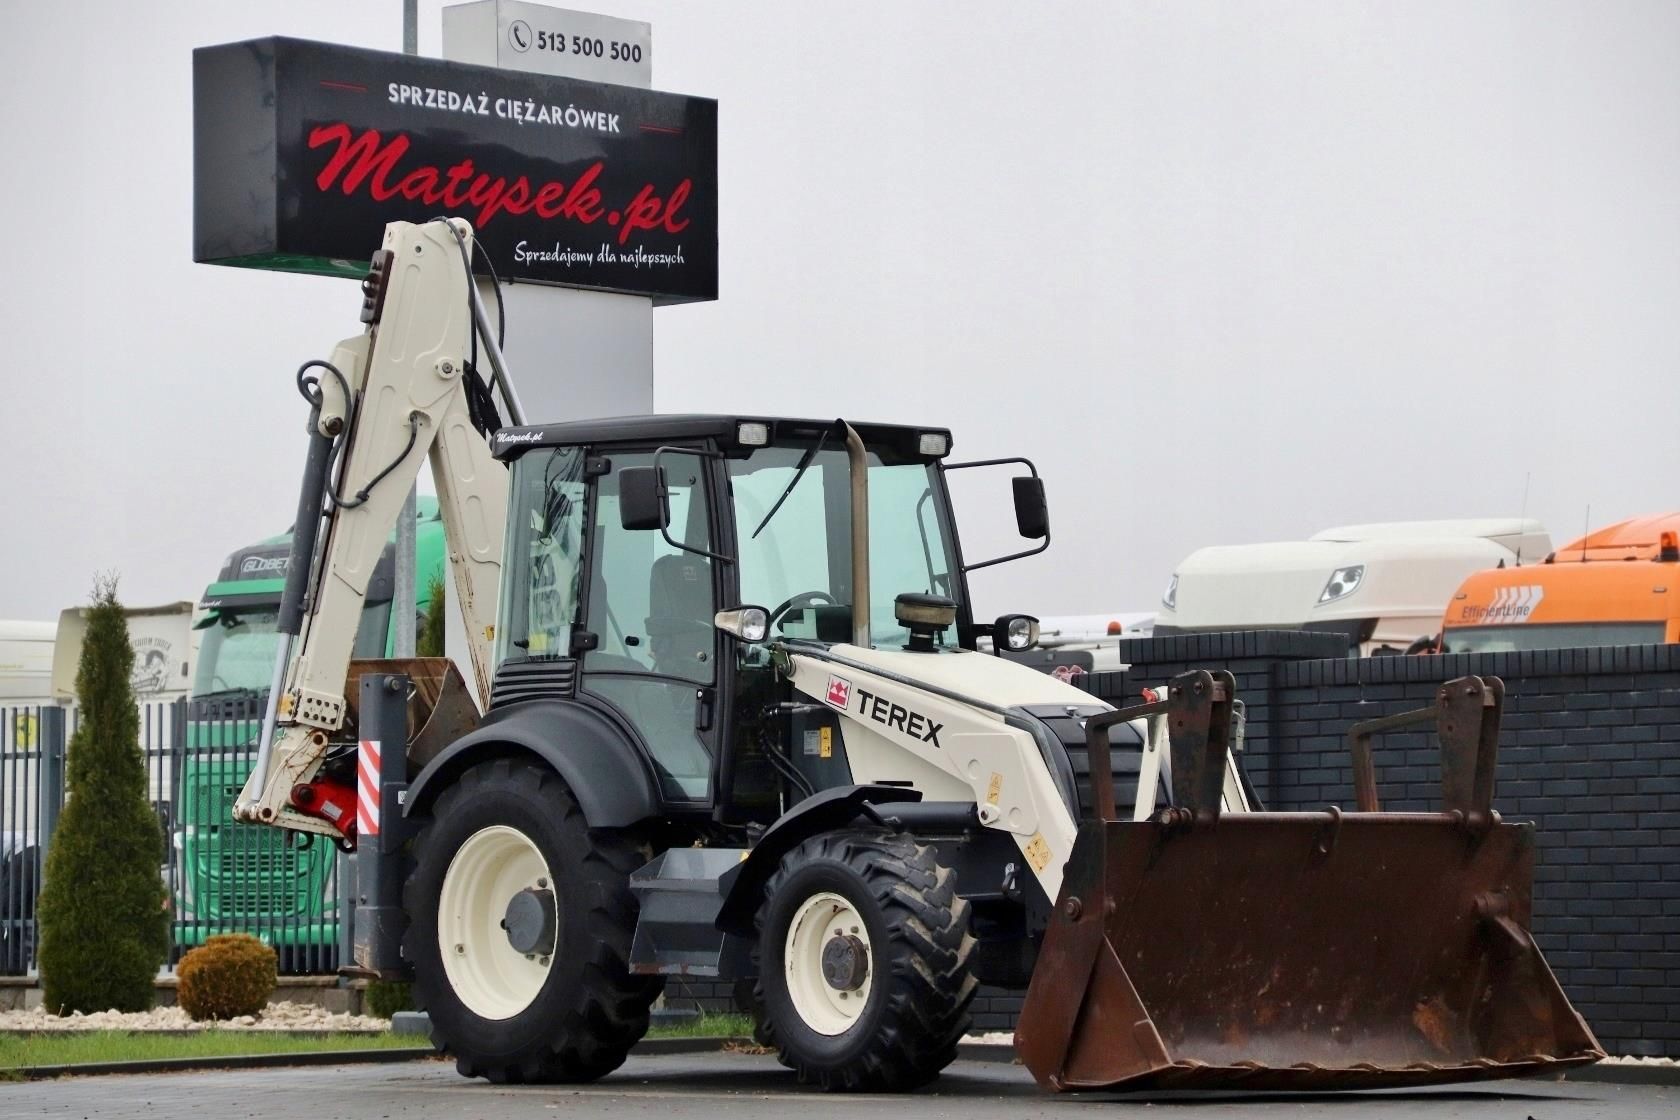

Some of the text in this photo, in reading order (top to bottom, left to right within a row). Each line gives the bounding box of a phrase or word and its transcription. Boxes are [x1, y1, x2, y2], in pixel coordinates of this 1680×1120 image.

[538, 30, 642, 63] 513 500 500
[388, 83, 620, 133] SPRZEDAŻ CIĘŻARÓWEK
[308, 122, 692, 245] Matysek.pl
[514, 240, 685, 269] Sprzedajemy dla najlepszych
[496, 431, 544, 444] Matysek.pl
[1462, 603, 1530, 619] EfficientLine
[857, 688, 944, 748] TEREX
